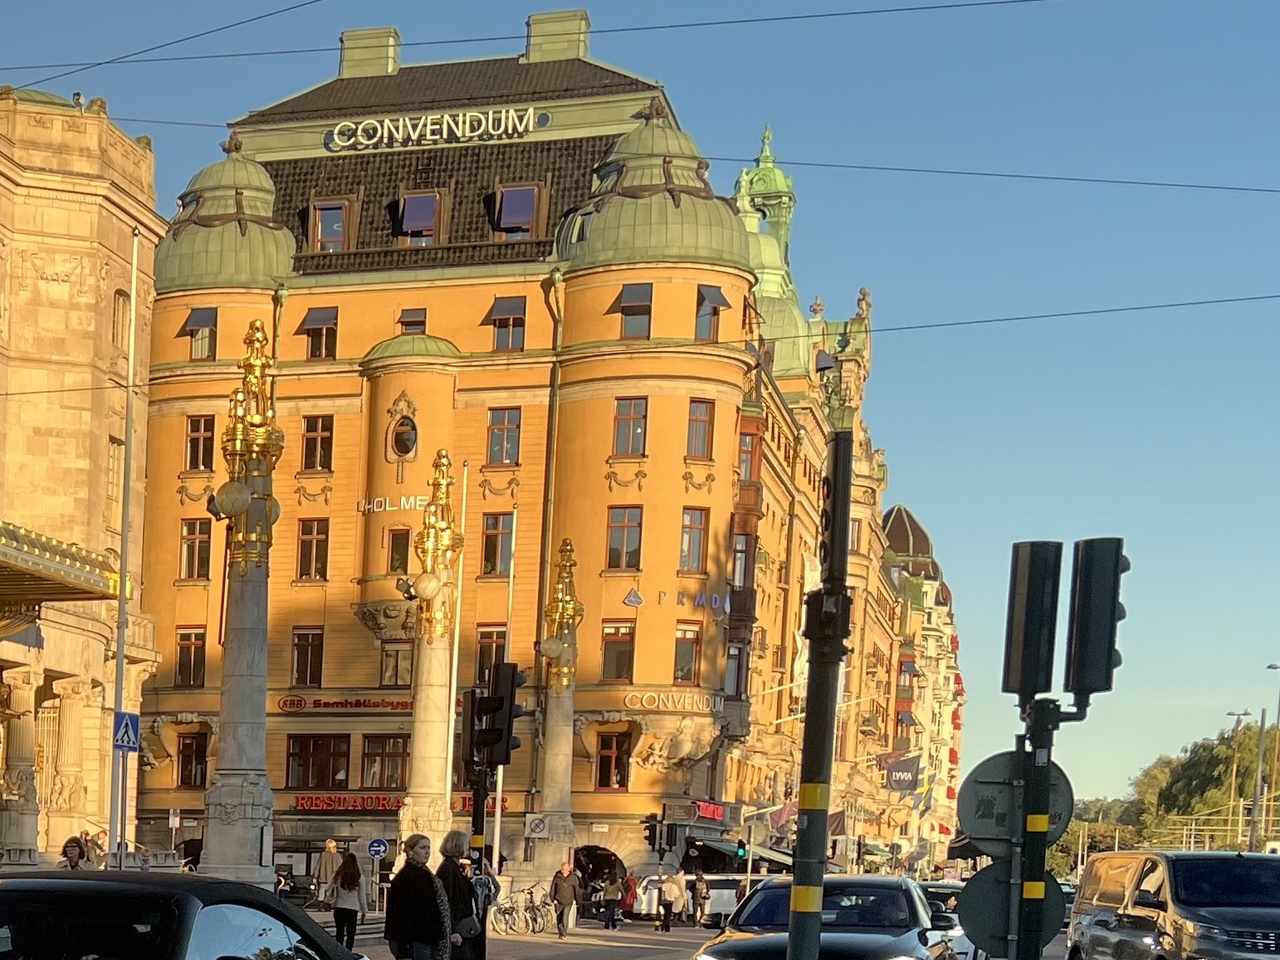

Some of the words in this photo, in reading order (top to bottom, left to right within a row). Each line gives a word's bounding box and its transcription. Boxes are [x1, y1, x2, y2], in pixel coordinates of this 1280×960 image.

[333, 107, 535, 147] CONVENDUM
[365, 495, 430, 514] HOLME
[282, 699, 303, 709] SBB
[624, 692, 725, 713] CONVENDUM
[296, 794, 406, 811] RESTAURA
